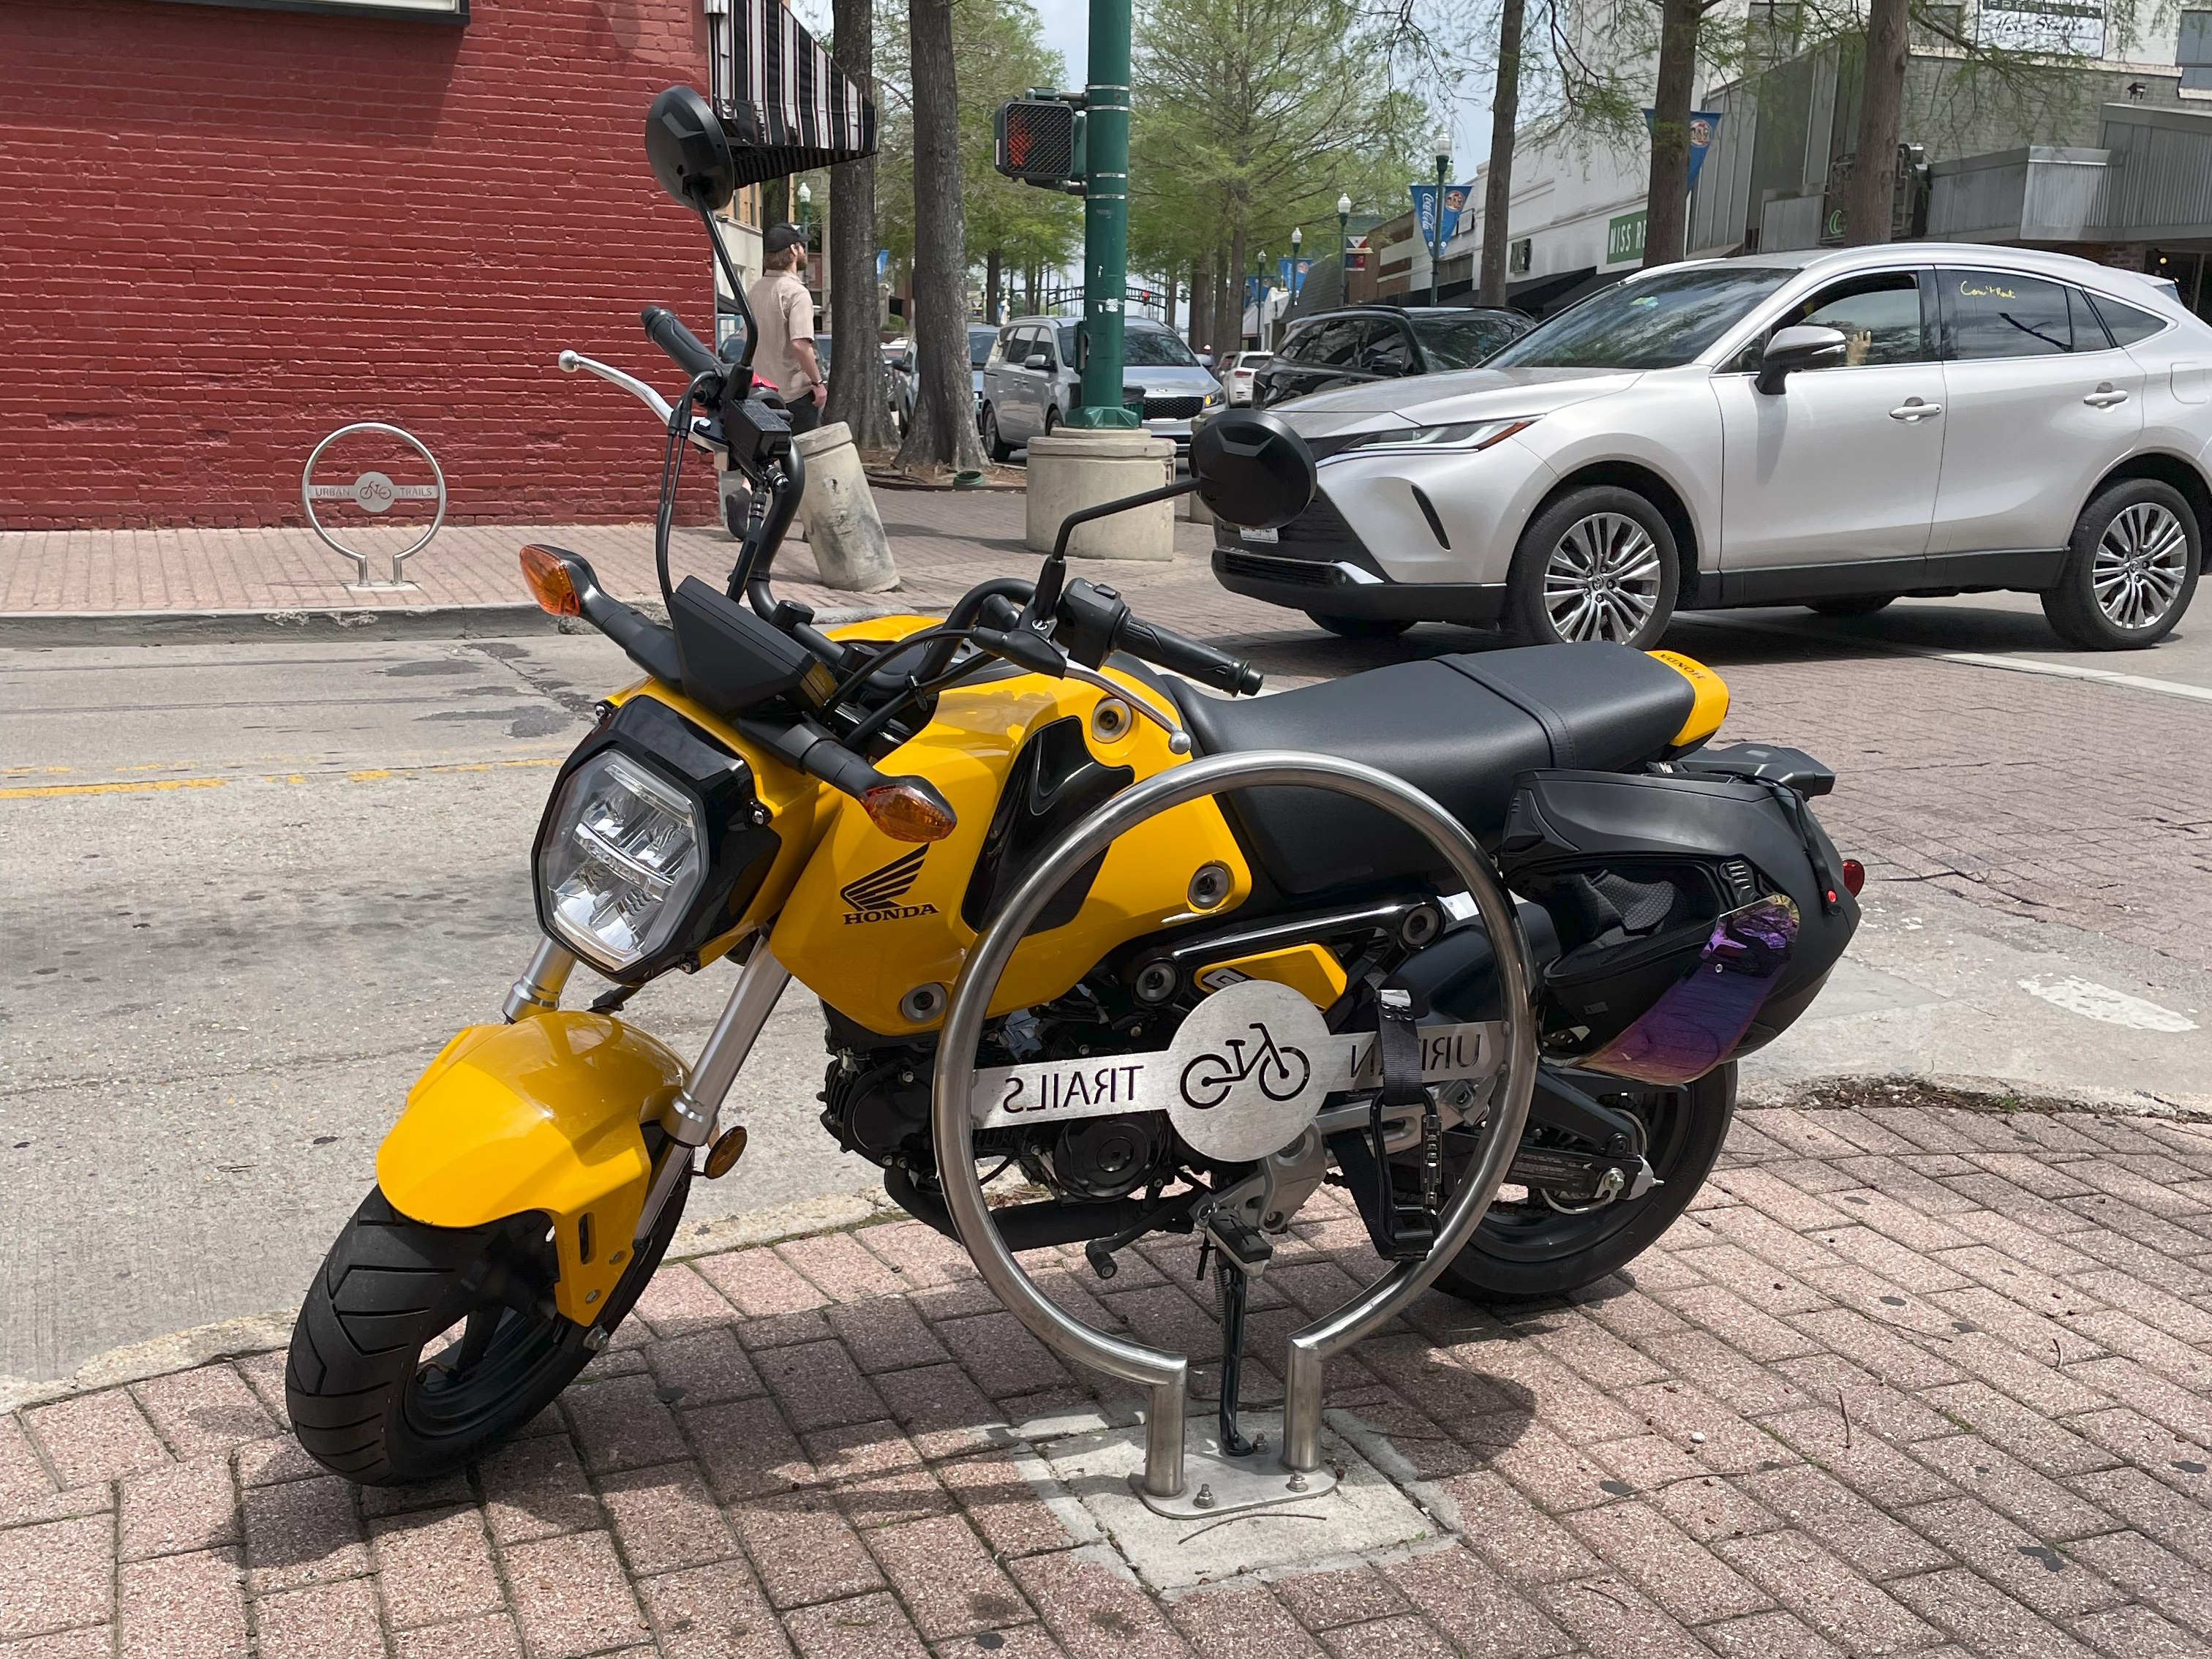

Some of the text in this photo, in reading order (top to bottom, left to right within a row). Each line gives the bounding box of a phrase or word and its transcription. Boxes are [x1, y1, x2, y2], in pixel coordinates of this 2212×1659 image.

[1609, 223, 1631, 255] MISS
[315, 486, 433, 497] URBAN TRAILS
[1659, 653, 1707, 680] HONDA
[586, 844, 641, 885] HONDA
[843, 903, 941, 925] HONDA
